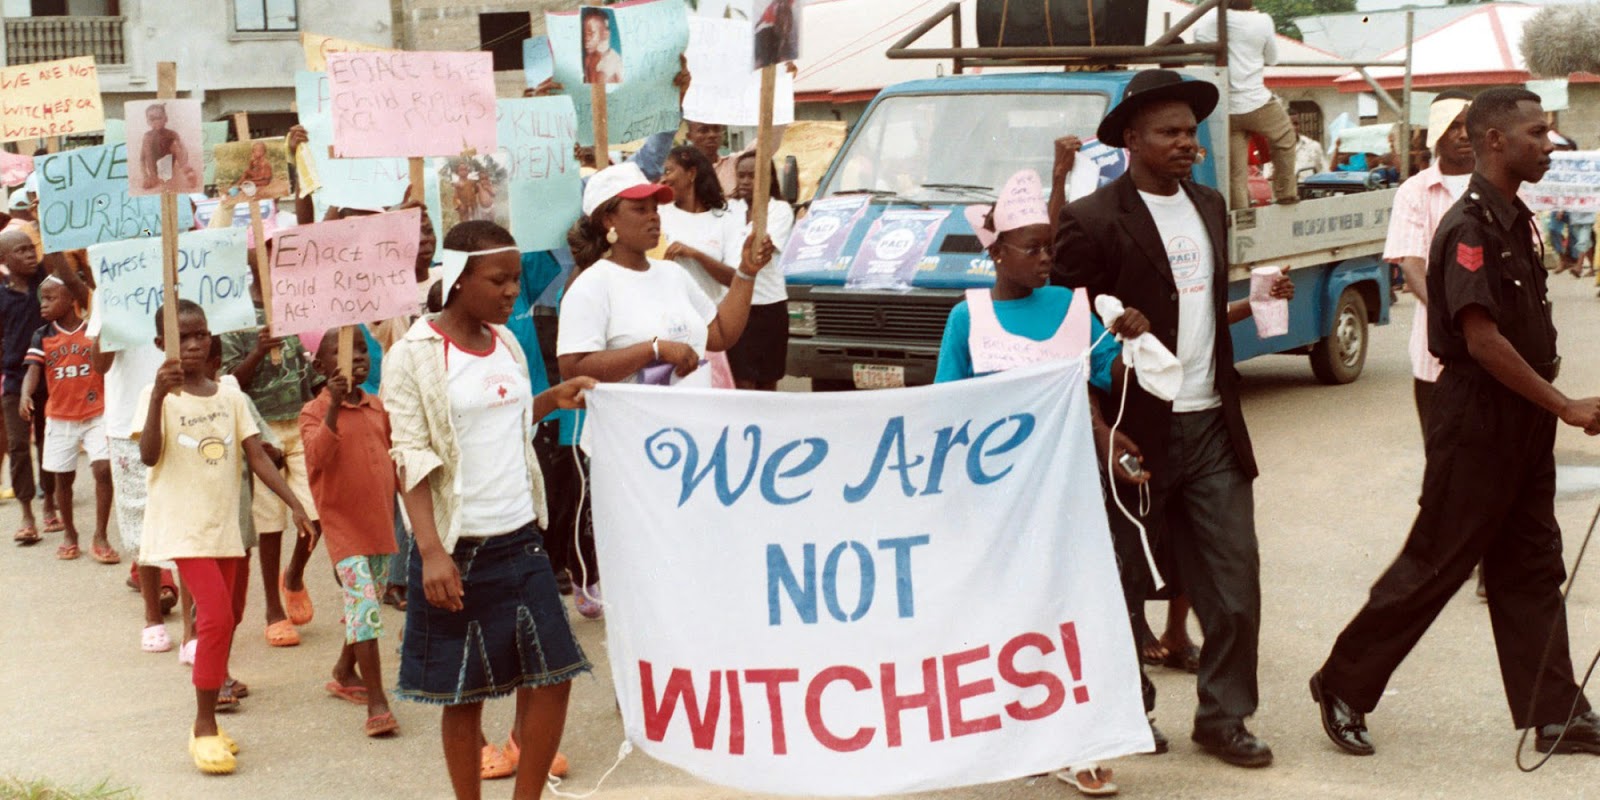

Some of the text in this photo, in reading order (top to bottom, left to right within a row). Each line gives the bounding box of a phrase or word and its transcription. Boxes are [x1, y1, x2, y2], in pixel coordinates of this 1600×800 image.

[0, 64, 95, 89] WE ARE NOT
[3, 98, 71, 120] WITCHES
[43, 143, 128, 191] GIVE
[44, 193, 110, 235] OUR
[879, 239, 910, 249] PACT
[1168, 252, 1197, 263] PACT
[54, 363, 91, 380] 392
[644, 412, 1035, 508] We Are
[766, 534, 930, 626] NOT
[638, 621, 1090, 755] WITCHES!
